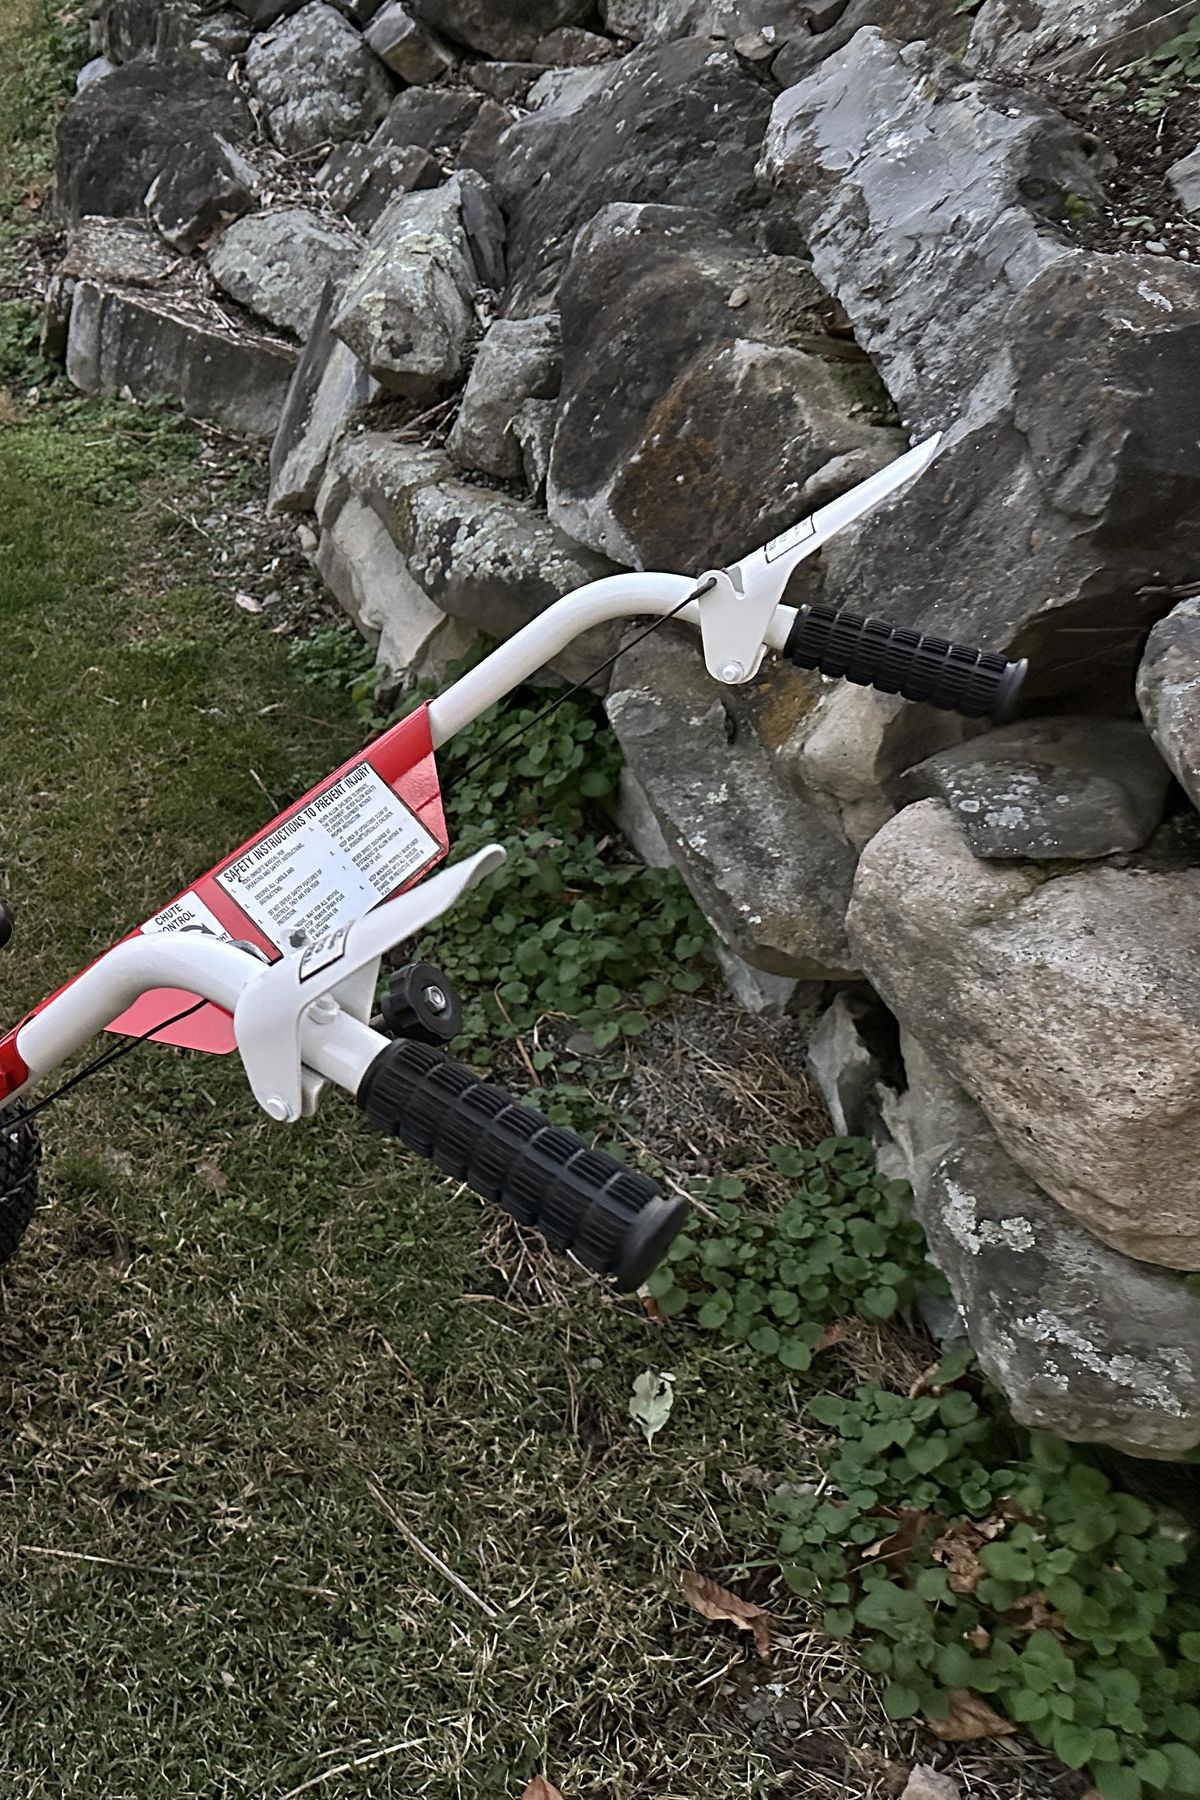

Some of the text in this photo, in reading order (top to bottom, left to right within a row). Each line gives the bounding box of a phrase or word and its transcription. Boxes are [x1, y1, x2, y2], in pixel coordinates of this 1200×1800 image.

[222, 764, 372, 883] SAFETY INSTRUCTIONS TO PREVENT INJURY
[268, 859, 283, 871] SAFETY
[267, 881, 276, 889] ALL
[289, 884, 304, 897] SAFETY
[154, 903, 183, 926] CHUTE
[158, 910, 196, 932] ONTROL
